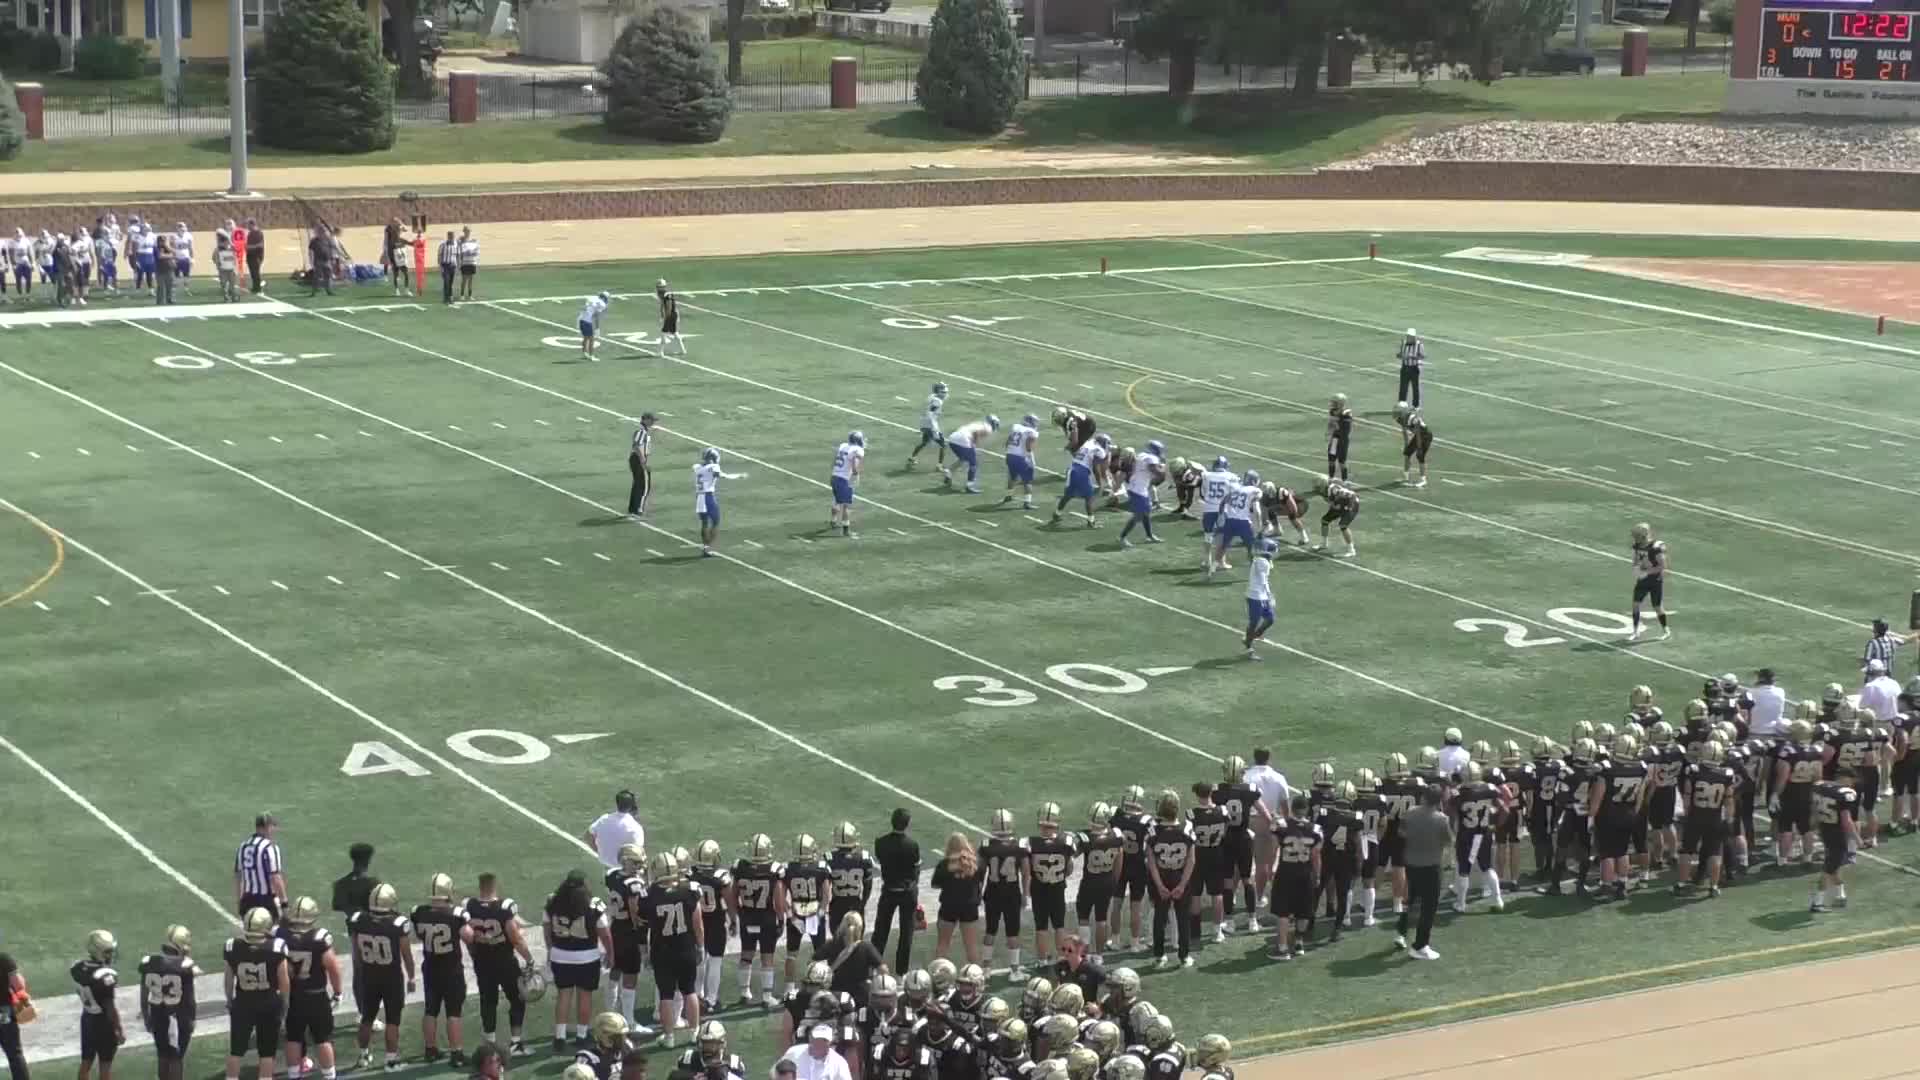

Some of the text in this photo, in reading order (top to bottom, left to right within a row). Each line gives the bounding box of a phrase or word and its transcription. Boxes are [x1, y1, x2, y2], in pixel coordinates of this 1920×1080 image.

[1843, 13, 1909, 37] 12:22
[1792, 47, 1822, 58] DOWN
[1830, 48, 1858, 59] TO GO
[1876, 49, 1898, 61] BALL
[1835, 61, 1855, 79] 15
[1879, 61, 1907, 80] 21
[1209, 481, 1225, 498] 55
[1452, 606, 1647, 649] 20
[932, 662, 1149, 709] 30
[340, 727, 552, 780] 40
[1331, 825, 1347, 850] 4
[989, 855, 1017, 882] 14
[1032, 853, 1065, 883] 52
[656, 903, 688, 936] 71
[418, 923, 453, 954] 72
